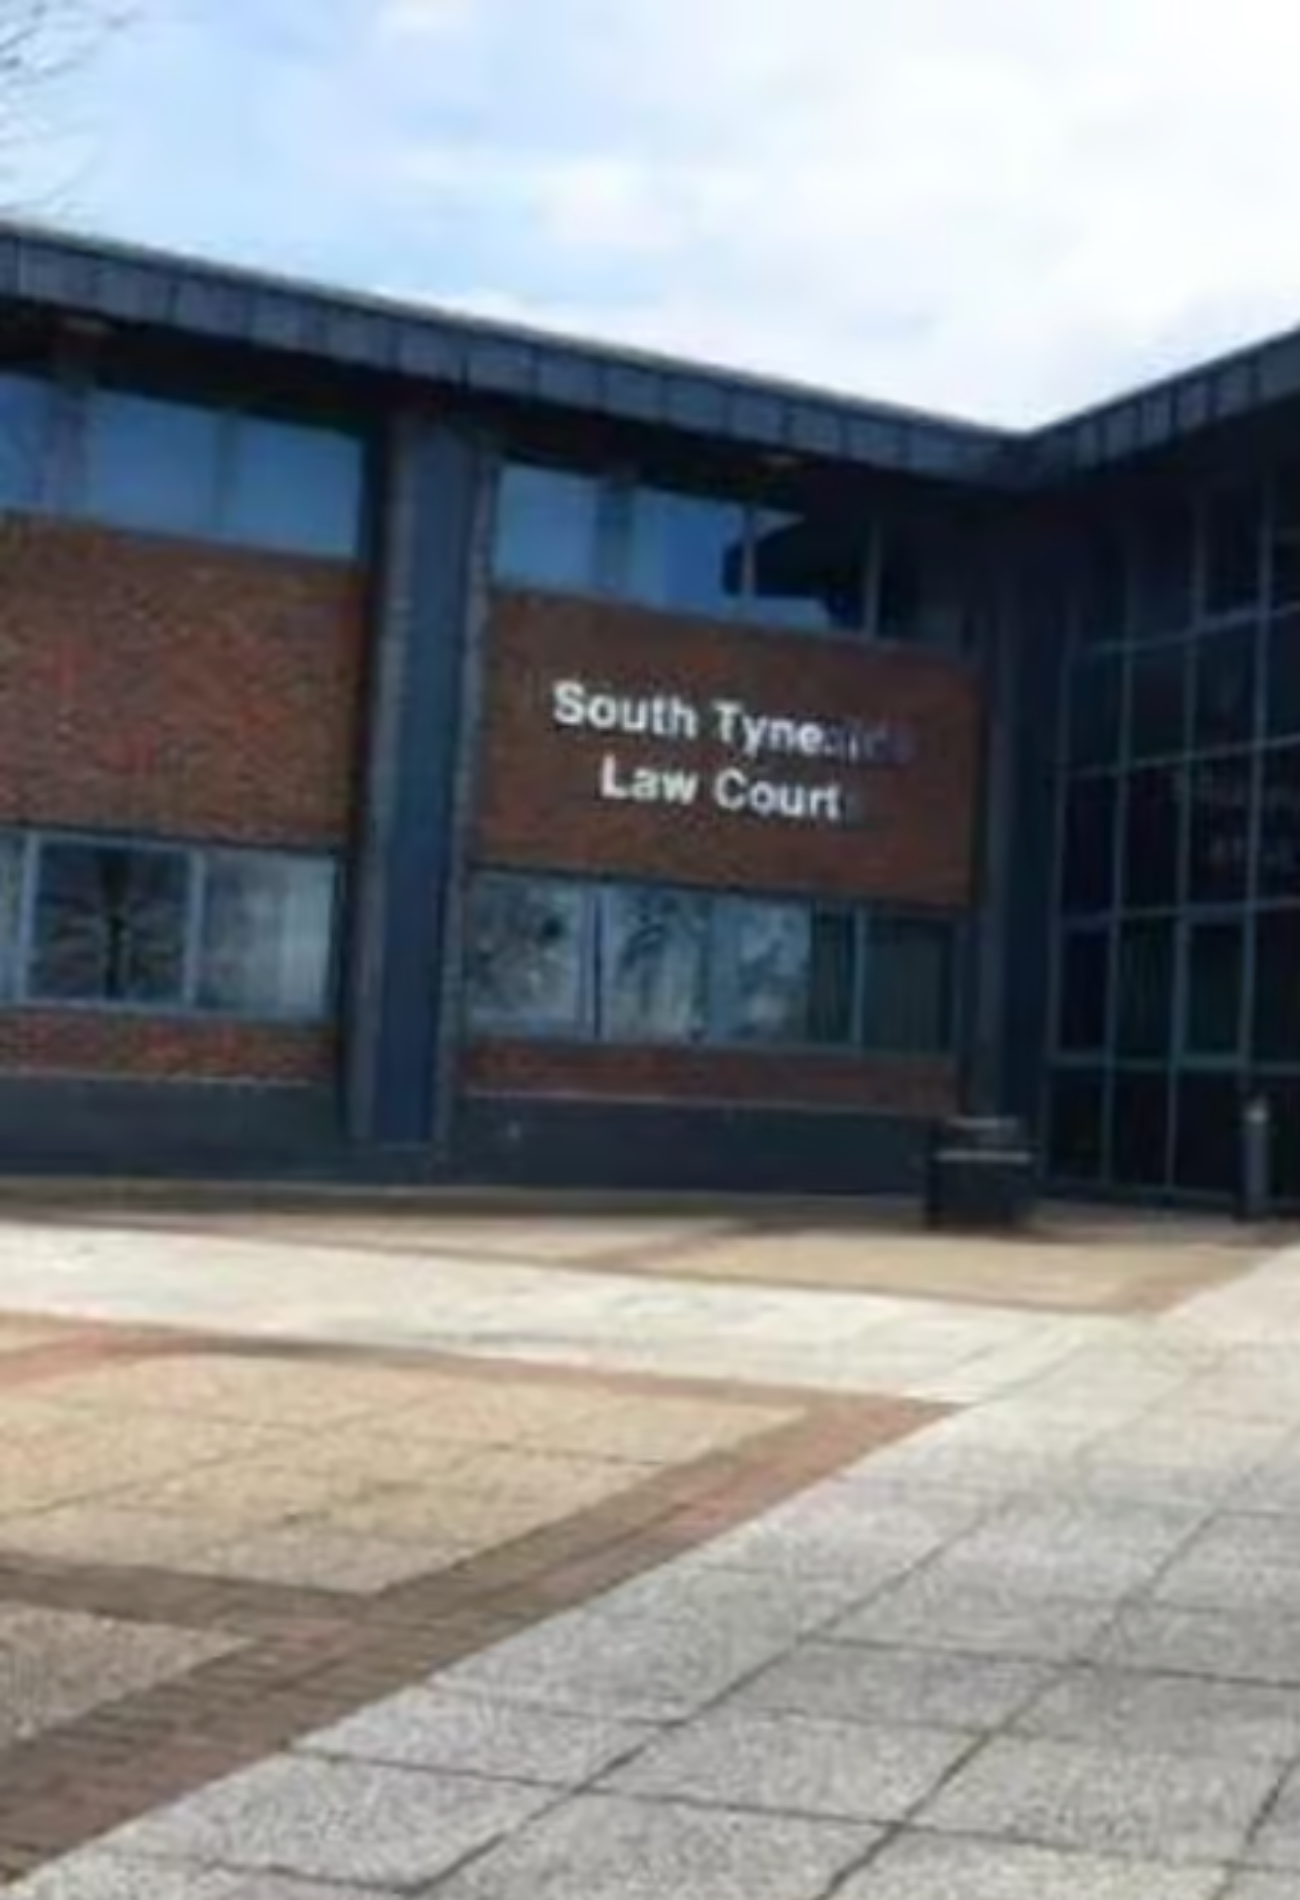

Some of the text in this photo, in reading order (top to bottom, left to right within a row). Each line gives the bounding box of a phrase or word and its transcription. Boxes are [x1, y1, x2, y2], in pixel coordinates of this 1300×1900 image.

[552, 679, 917, 764] South Tyneid
[601, 754, 862, 821] Law Court
